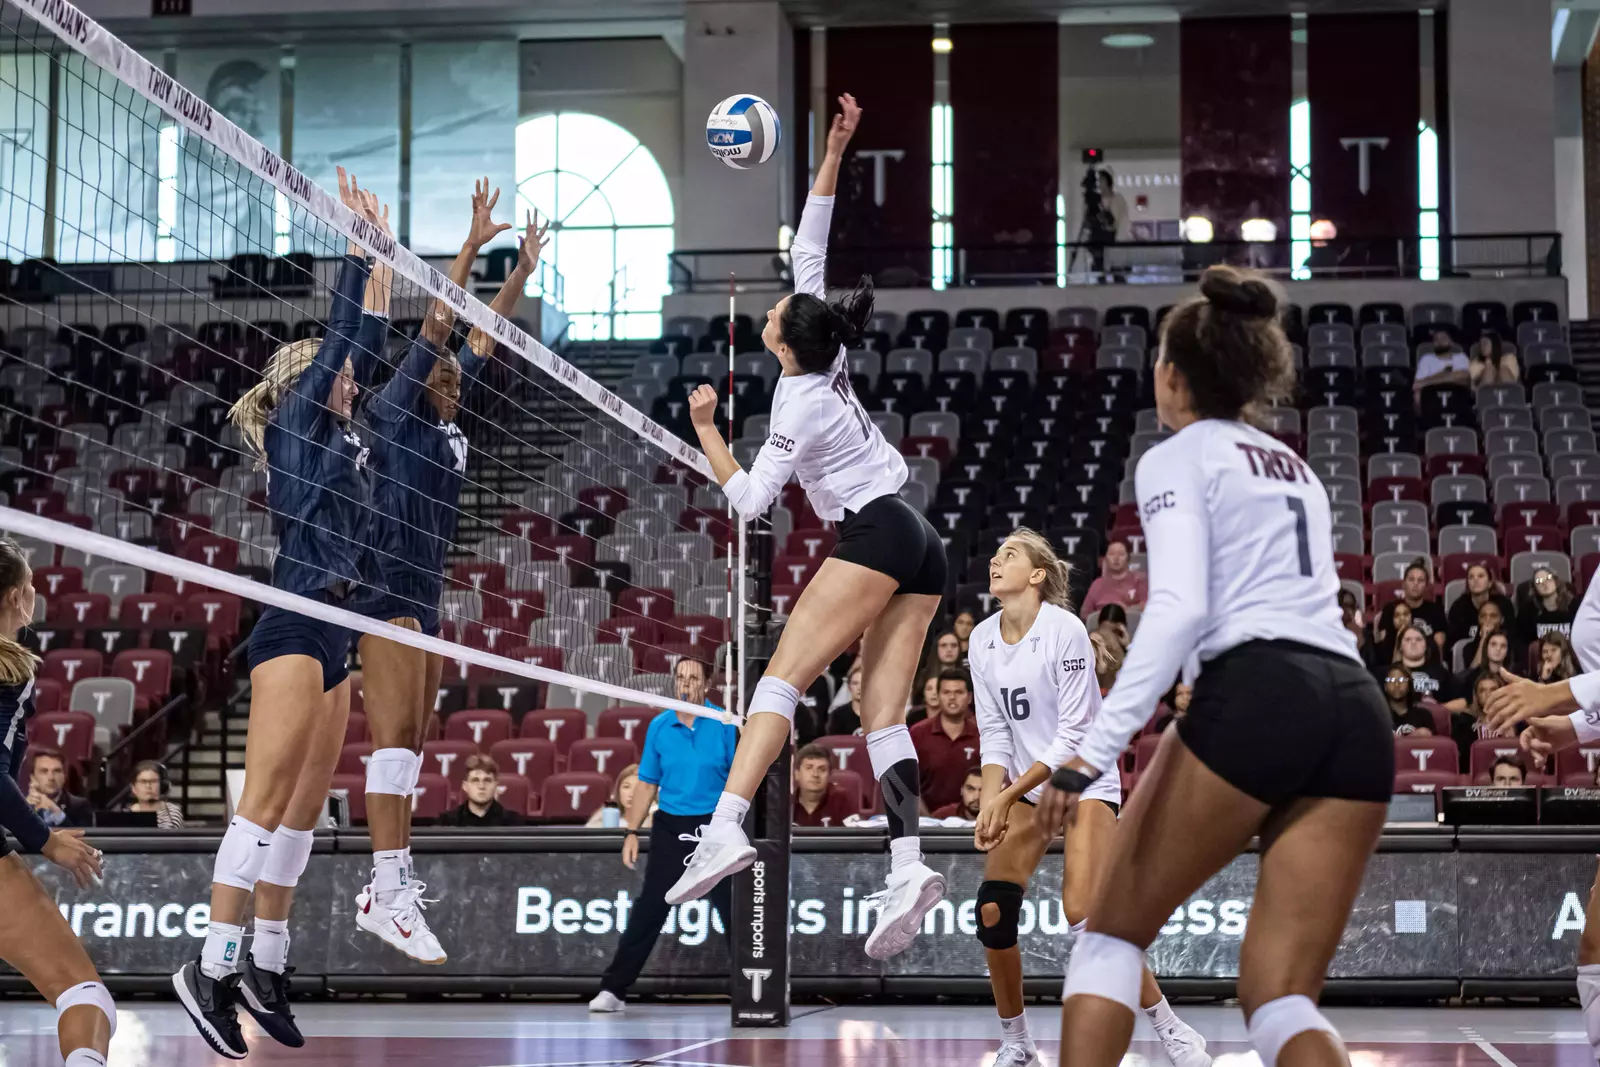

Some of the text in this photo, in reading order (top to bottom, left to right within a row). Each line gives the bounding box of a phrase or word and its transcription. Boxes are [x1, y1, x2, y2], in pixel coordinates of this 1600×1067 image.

[148, 66, 213, 131] TROY TROJANS
[260, 147, 281, 178] TROY
[711, 147, 741, 158] molte
[1339, 137, 1389, 196] T
[856, 150, 905, 207] T
[1235, 441, 1311, 485] TROY
[1286, 495, 1313, 577] 1
[1000, 686, 1030, 721] 16
[515, 886, 633, 934] Best
[751, 860, 765, 959] sports imports
[1552, 891, 1587, 940] A
[742, 968, 773, 1002] T
